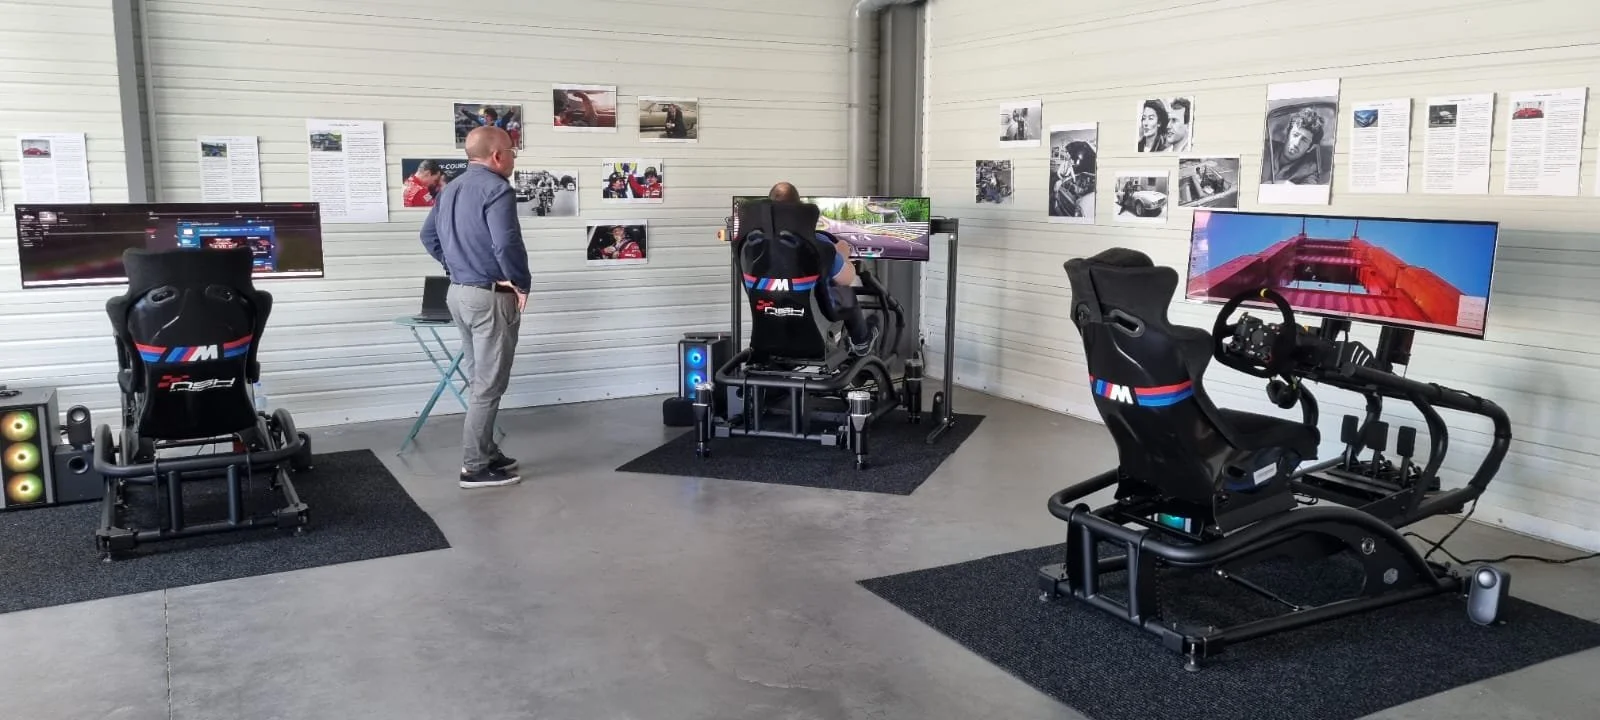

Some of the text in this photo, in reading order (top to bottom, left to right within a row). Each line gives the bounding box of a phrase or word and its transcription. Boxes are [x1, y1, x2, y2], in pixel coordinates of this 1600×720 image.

[769, 278, 789, 292] M
[189, 344, 219, 362] M
[1110, 384, 1134, 405] M
